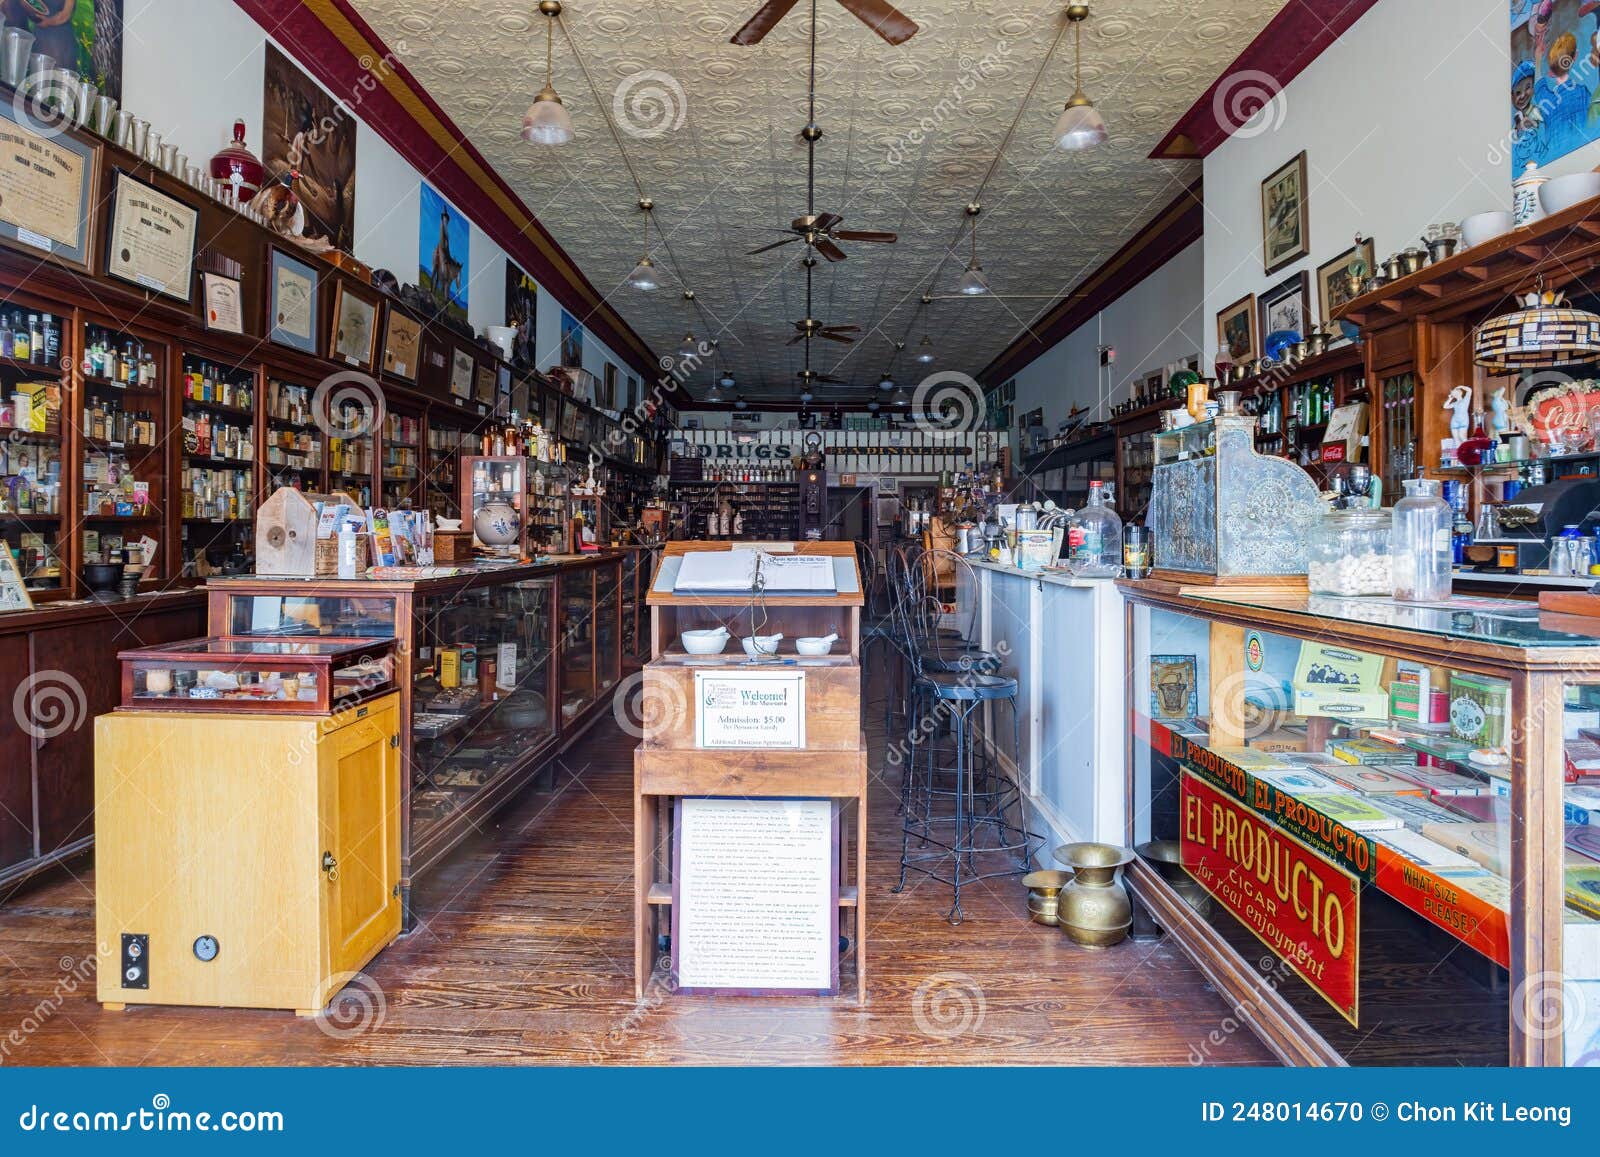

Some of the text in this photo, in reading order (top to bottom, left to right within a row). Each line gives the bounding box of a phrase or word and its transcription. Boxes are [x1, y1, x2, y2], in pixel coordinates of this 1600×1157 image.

[699, 444, 791, 458] DRUGS
[718, 715, 786, 724] Admission: $5.00
[1174, 734, 1246, 797] EL PRODUCTO
[1254, 779, 1271, 810] EL
[1275, 789, 1369, 872] PRODUCTO
[1288, 822, 1301, 837] real
[1301, 831, 1338, 858] enjoyment
[1186, 794, 1345, 960] EL PRODUCTO
[1229, 868, 1279, 918] CIGAR
[1402, 864, 1458, 906] WHAT SIZE
[1195, 854, 1326, 982] for real enjoyment
